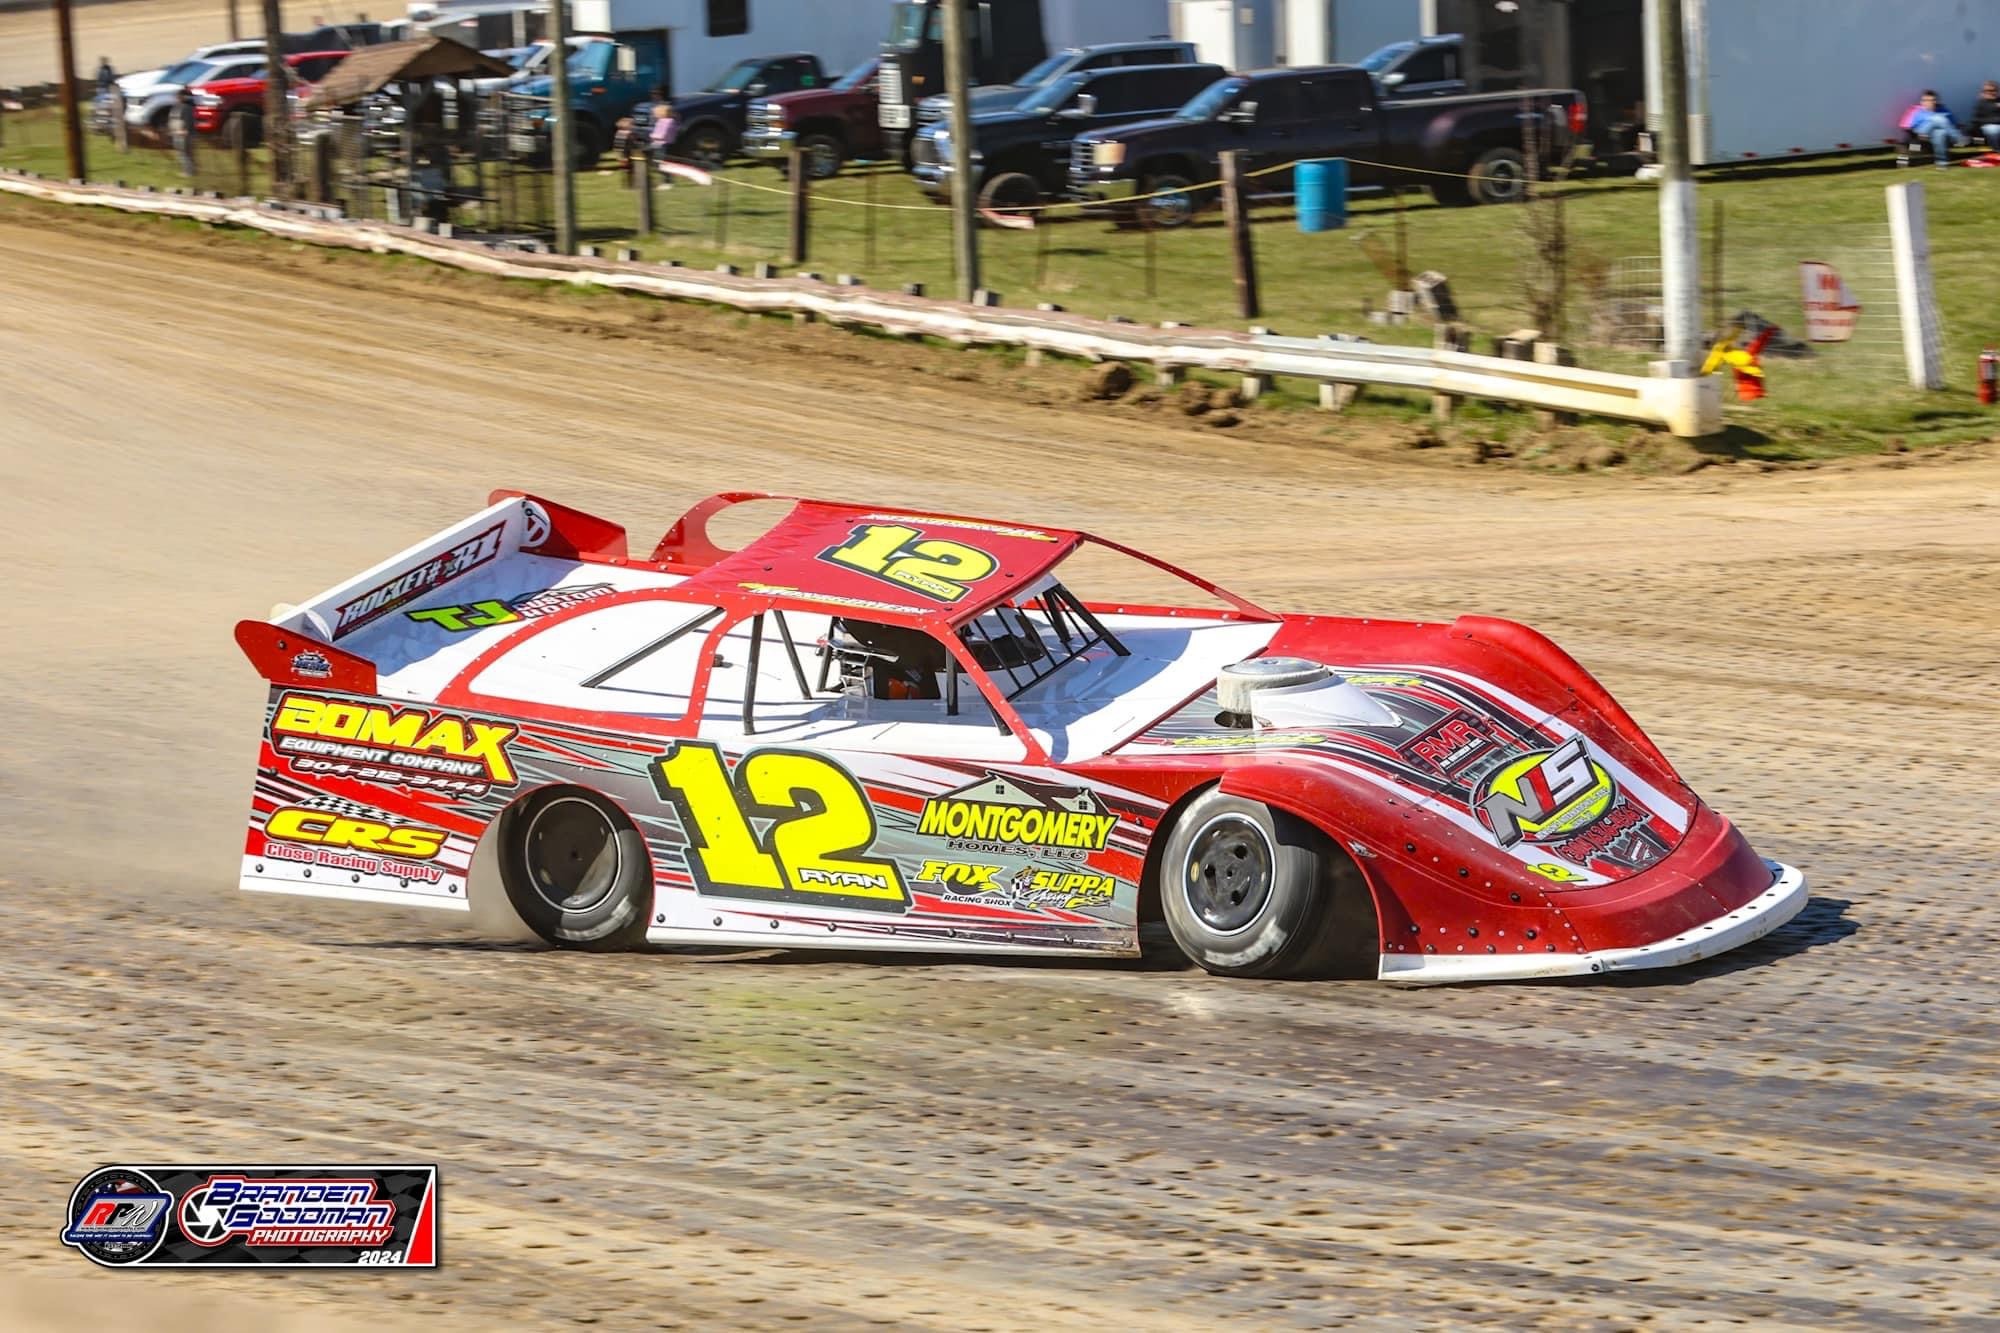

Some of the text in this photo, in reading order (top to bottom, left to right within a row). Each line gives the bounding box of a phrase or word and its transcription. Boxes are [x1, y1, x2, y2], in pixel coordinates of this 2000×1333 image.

[832, 524, 992, 602] 12
[405, 600, 521, 631] TJ
[274, 697, 515, 783] BOMAX
[280, 737, 484, 775] EQUIPMENT COMPANY
[1410, 719, 1491, 774] RMR
[295, 758, 488, 794] 304-212-3444
[265, 808, 446, 858] CRS
[660, 745, 905, 901] 12
[919, 800, 1118, 850] MONTGOMERY
[267, 842, 442, 881] Close Racing Supply
[915, 861, 1003, 886] FOX
[1041, 848, 1088, 861] LLC
[798, 867, 888, 889] RYAN
[1030, 871, 1116, 897] SUPPA
[943, 894, 1012, 907] RACING SHOX
